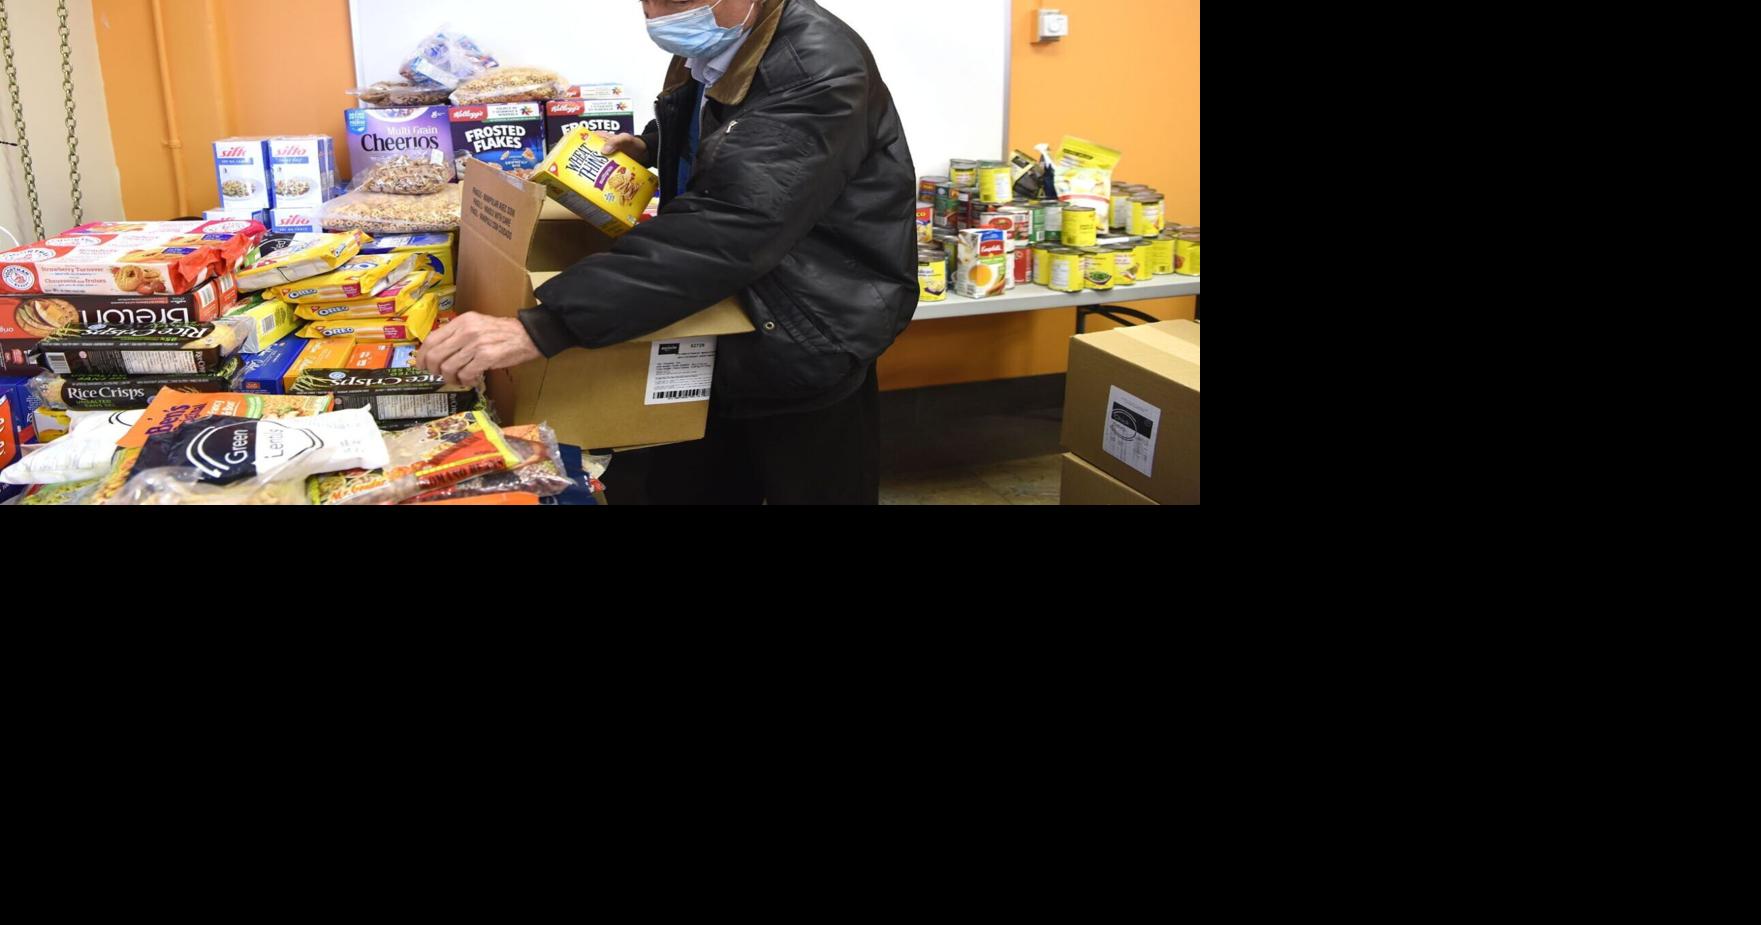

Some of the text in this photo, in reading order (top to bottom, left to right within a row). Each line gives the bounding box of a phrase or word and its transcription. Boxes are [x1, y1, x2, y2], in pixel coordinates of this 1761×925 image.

[387, 126, 438, 136] Multi Grain
[464, 125, 526, 143] FROSTED
[360, 133, 439, 152] Cheerios
[473, 136, 522, 153] FLAKES
[565, 142, 593, 172] WHEAT
[578, 151, 609, 183] THINS
[288, 288, 318, 299] OREO
[82, 307, 189, 325] Breton
[317, 305, 350, 316] OREO
[80, 325, 209, 339] Rice Crisps
[322, 327, 355, 337] OREO
[328, 376, 402, 387] Crisps
[67, 386, 145, 400] Rice Crisps
[145, 404, 191, 435] Ben's
[224, 428, 250, 465] Green
